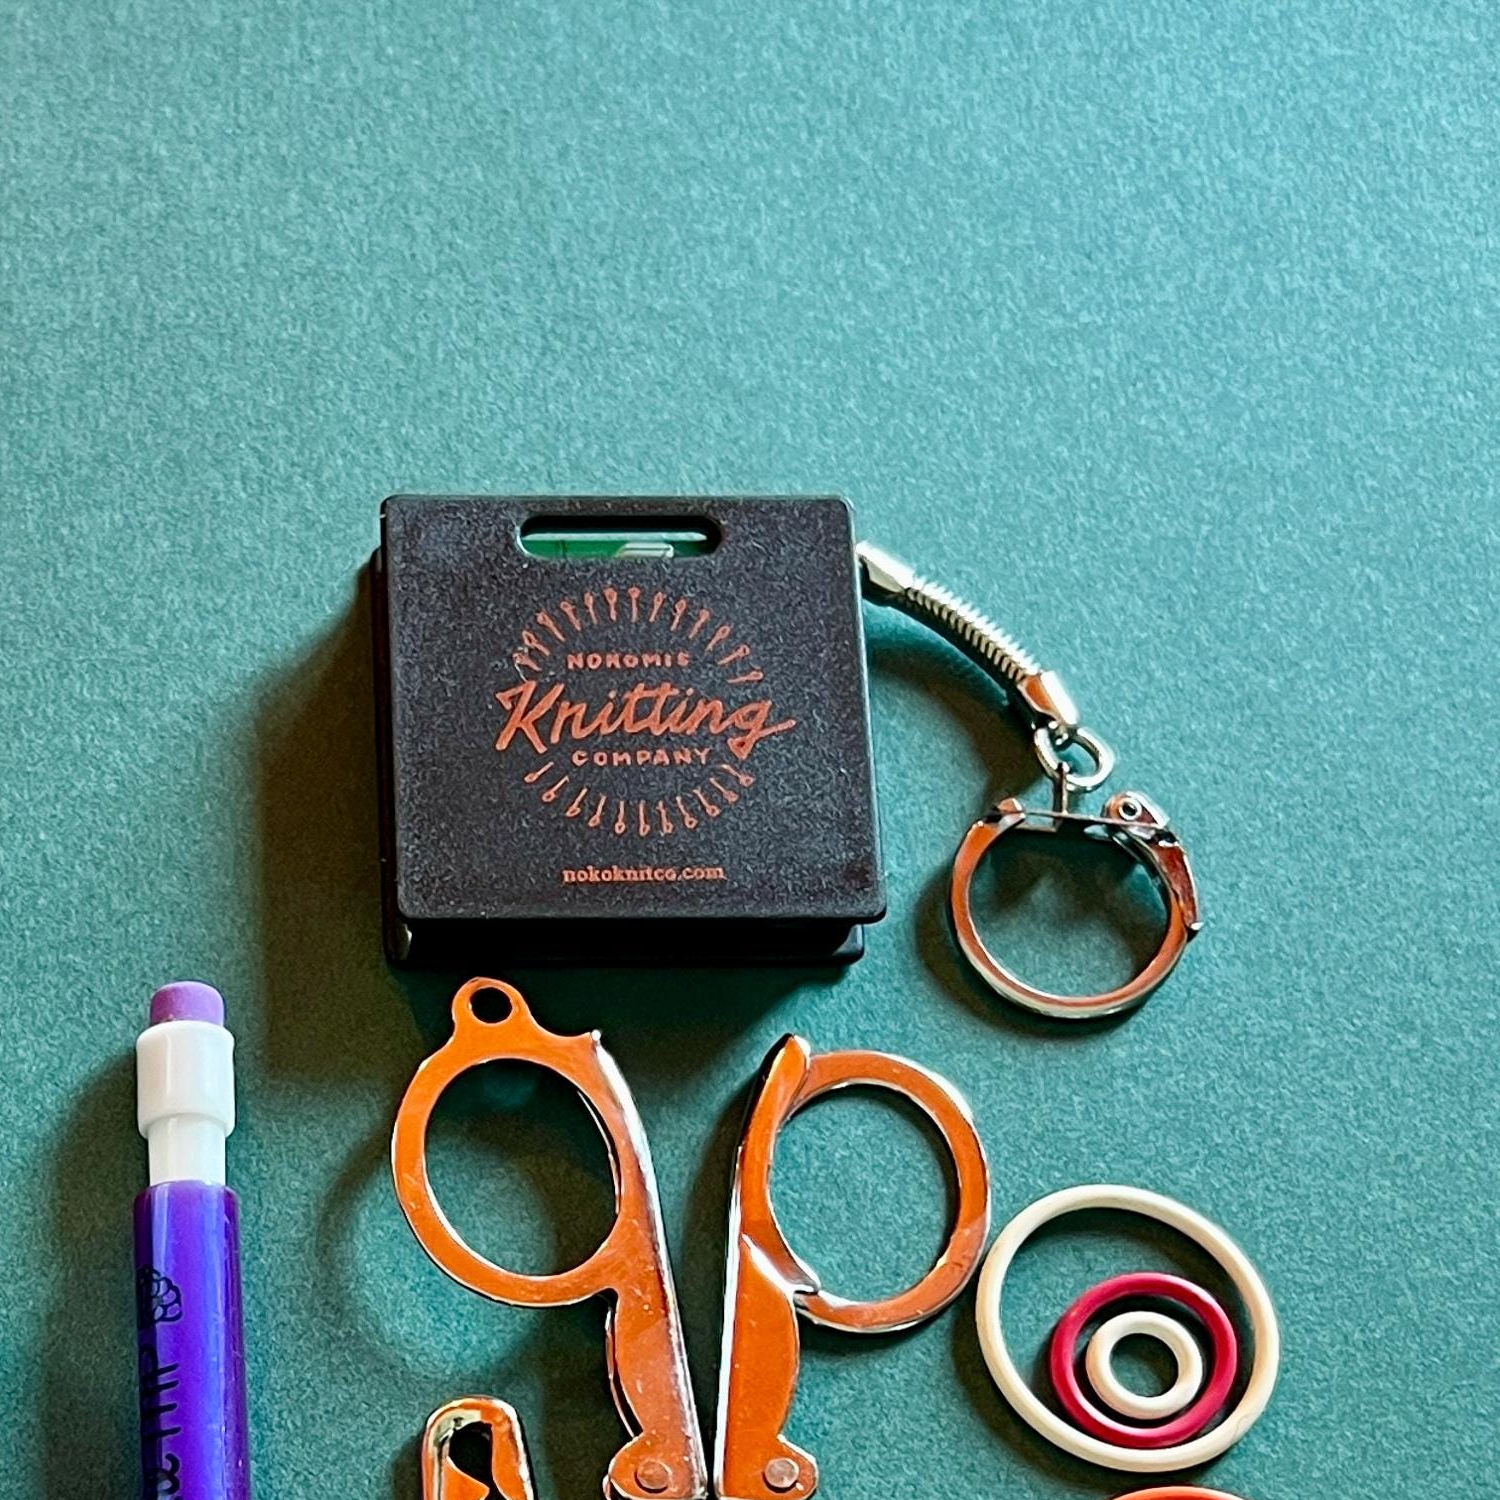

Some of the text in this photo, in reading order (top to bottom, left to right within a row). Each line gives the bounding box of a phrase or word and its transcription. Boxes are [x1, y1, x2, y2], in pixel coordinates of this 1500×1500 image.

[565, 651, 689, 670] NOKOMIS
[493, 678, 794, 761] Knitting
[570, 747, 709, 767] COMPANY
